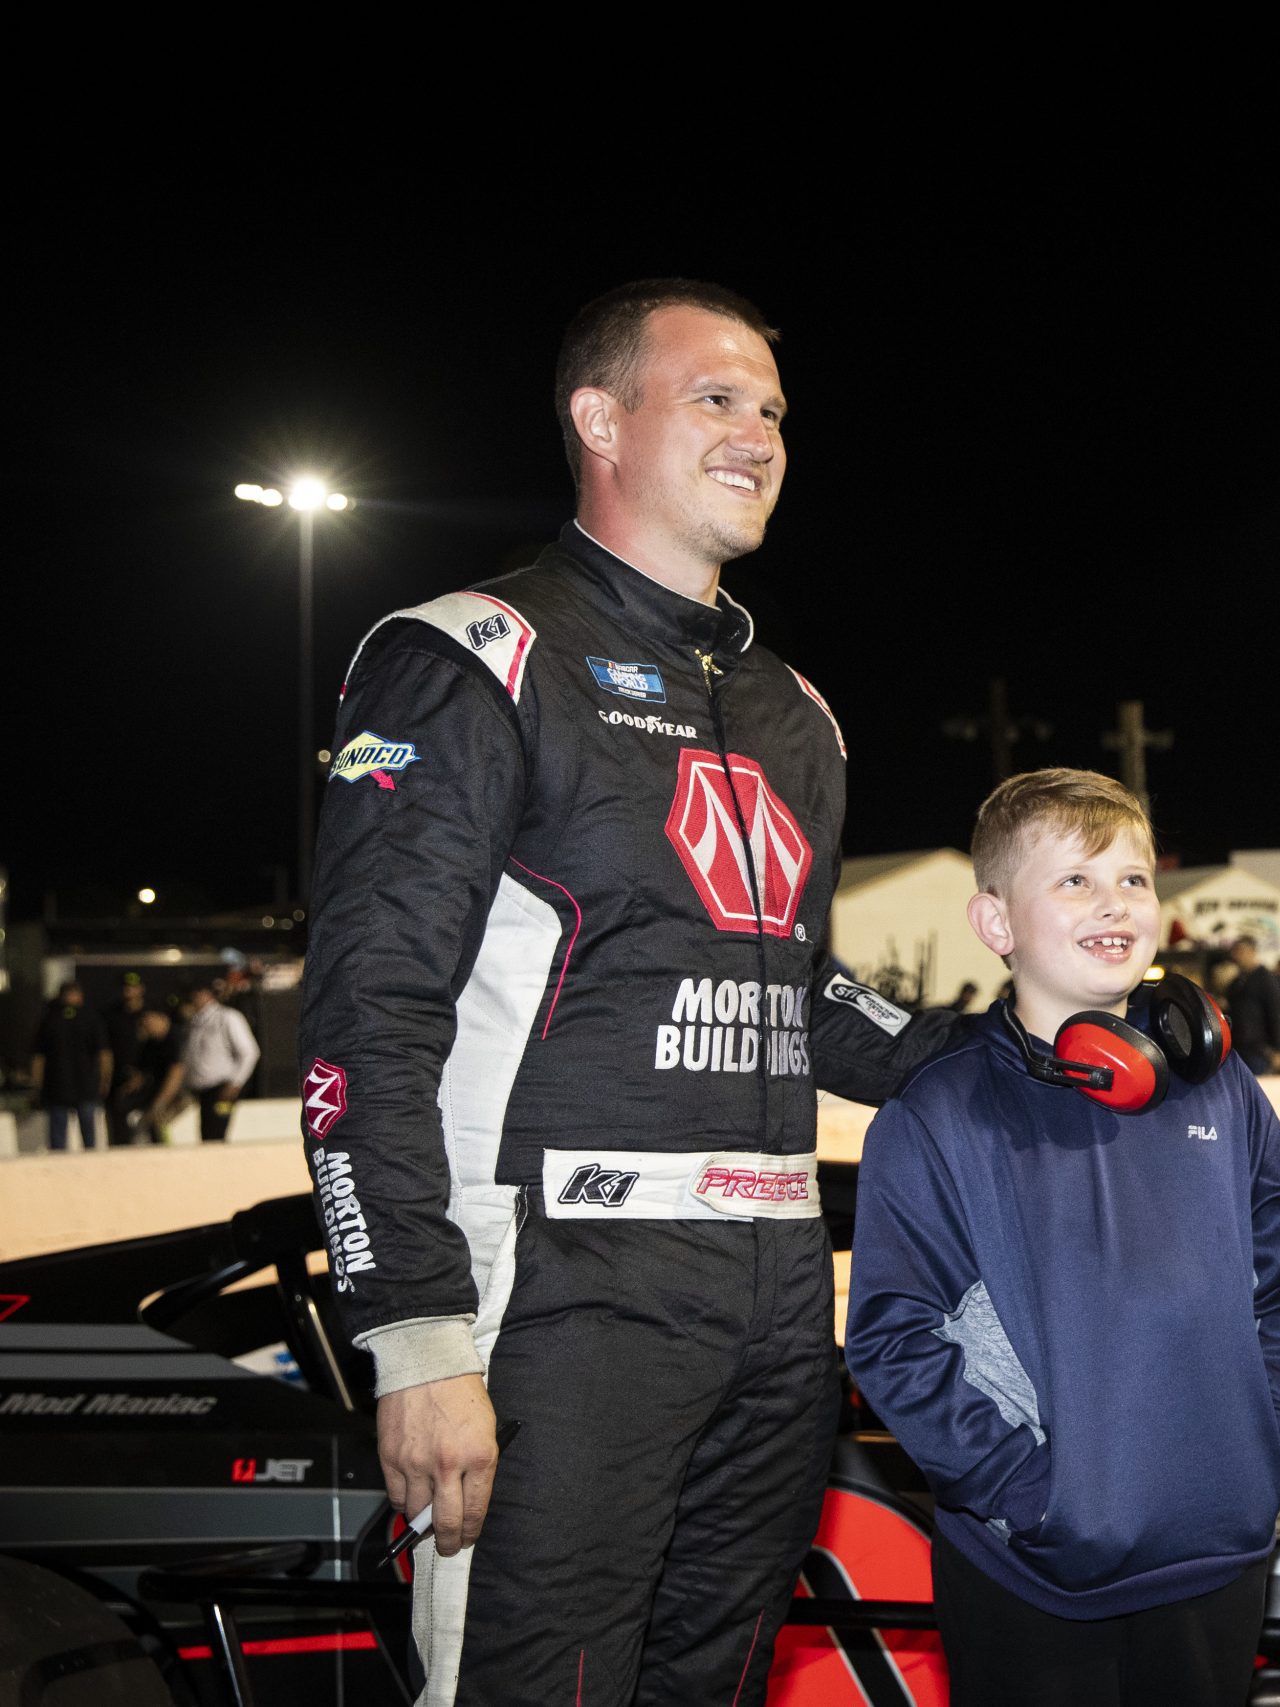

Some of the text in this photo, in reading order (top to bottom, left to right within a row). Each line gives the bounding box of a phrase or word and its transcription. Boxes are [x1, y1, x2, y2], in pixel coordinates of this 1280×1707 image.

[466, 613, 511, 650] K1
[598, 710, 698, 739] GOODYEAR
[330, 745, 409, 774] SUNOCO
[654, 1024, 811, 1077] BUILDINGS
[1187, 1125, 1218, 1141] FILA
[557, 1163, 640, 1207] K1
[696, 1167, 809, 1201] PREECE
[312, 1147, 356, 1294] BUILDINGS
[326, 1151, 377, 1274] MORTON
